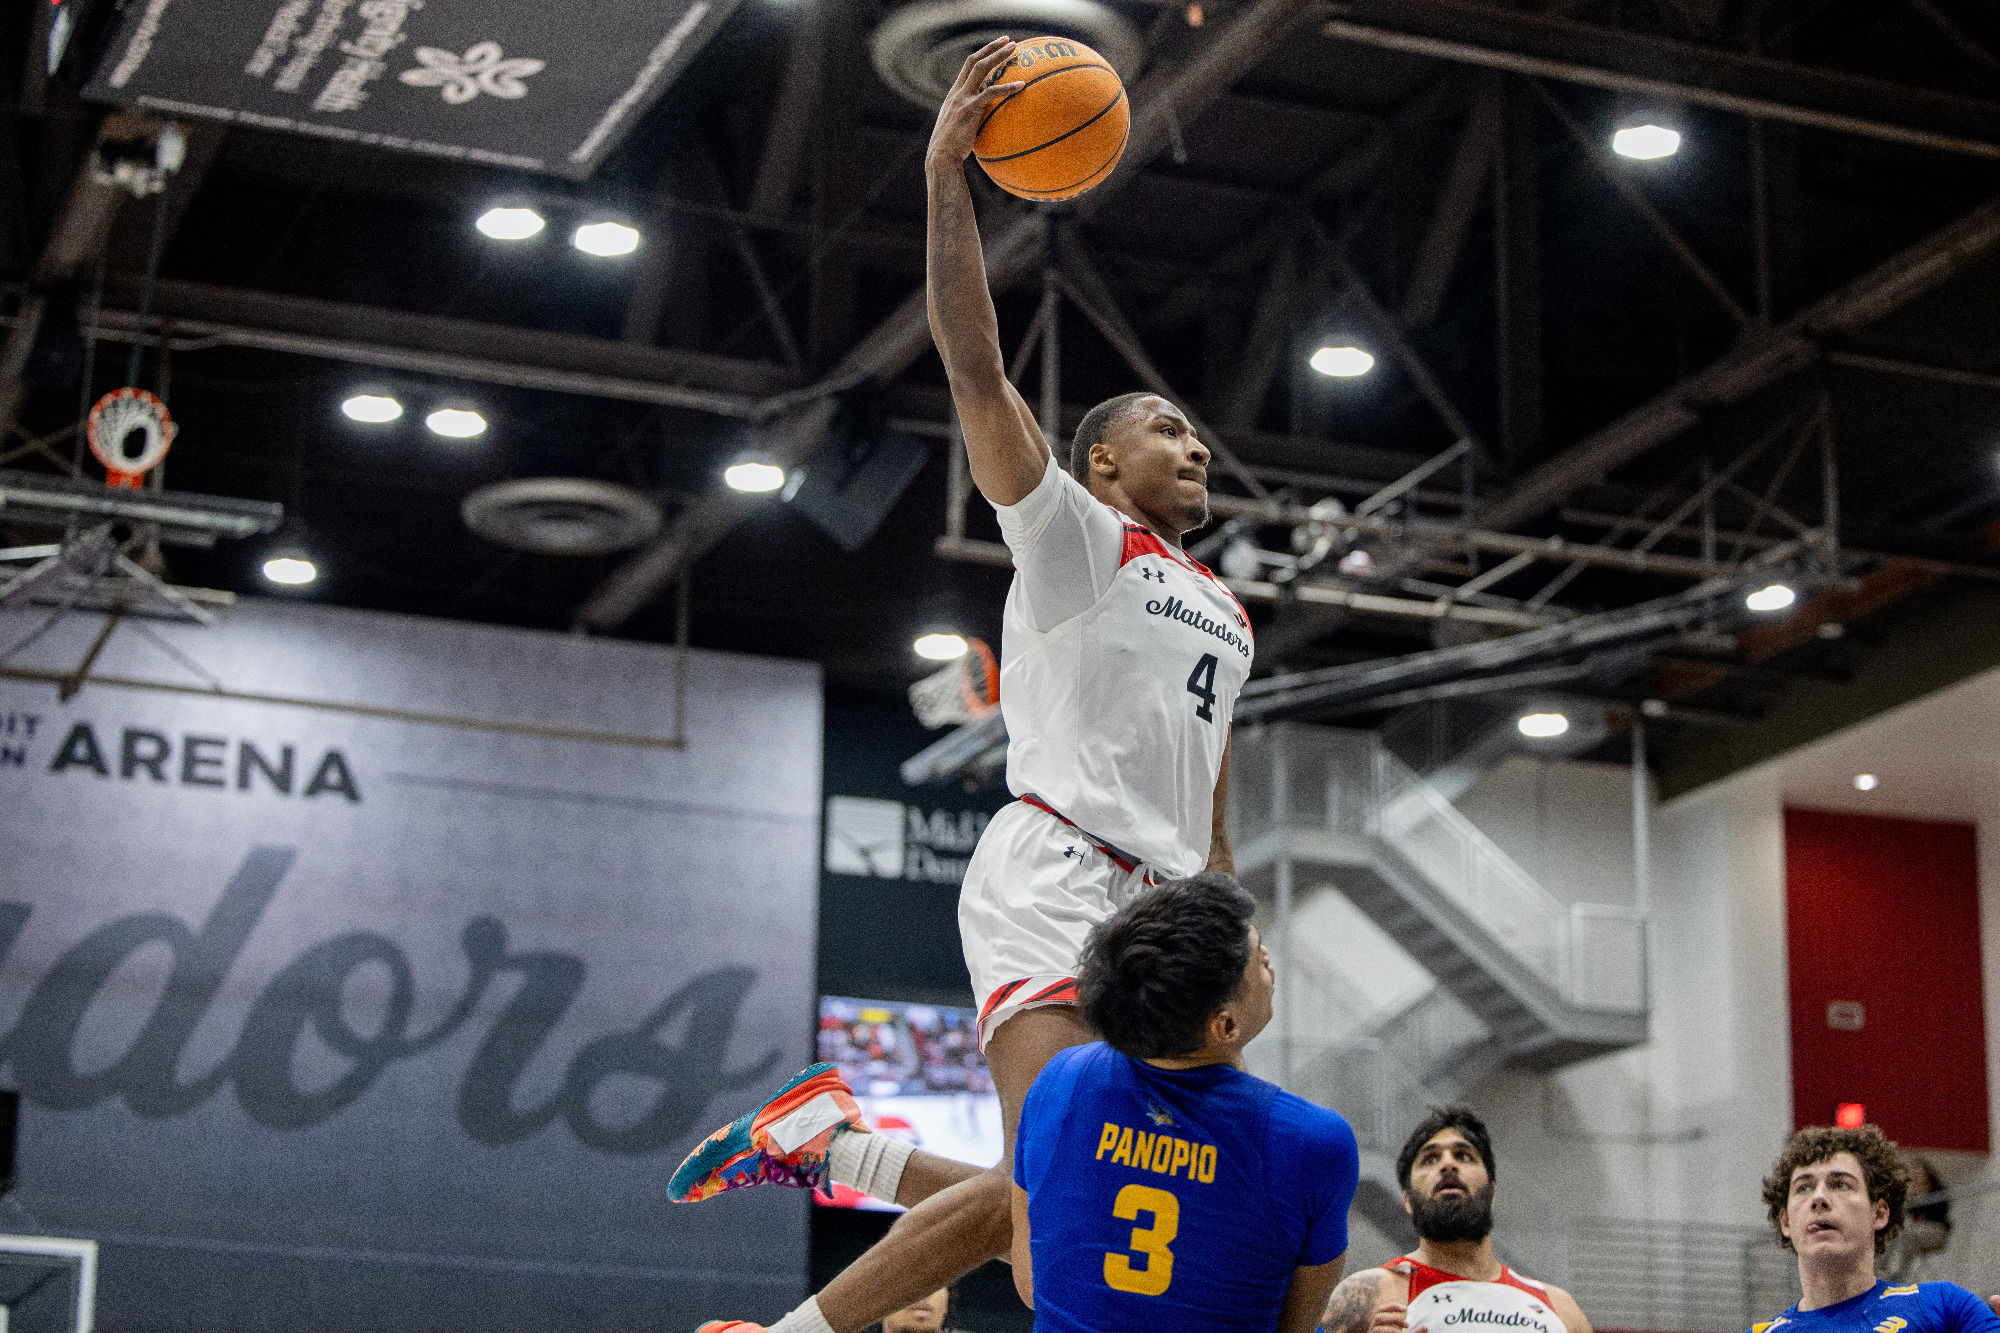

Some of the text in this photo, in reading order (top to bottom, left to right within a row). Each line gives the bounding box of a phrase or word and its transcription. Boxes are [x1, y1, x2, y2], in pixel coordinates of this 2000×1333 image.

[1146, 595, 1250, 658] Matadors
[1186, 652, 1219, 725] 4
[0, 711, 43, 741] IT
[51, 720, 363, 805] ARENA
[0, 845, 784, 1156] dors
[1095, 1122, 1218, 1184] PANOPIO
[1103, 1184, 1180, 1296] 3
[1444, 1308, 1550, 1333] Matadors
